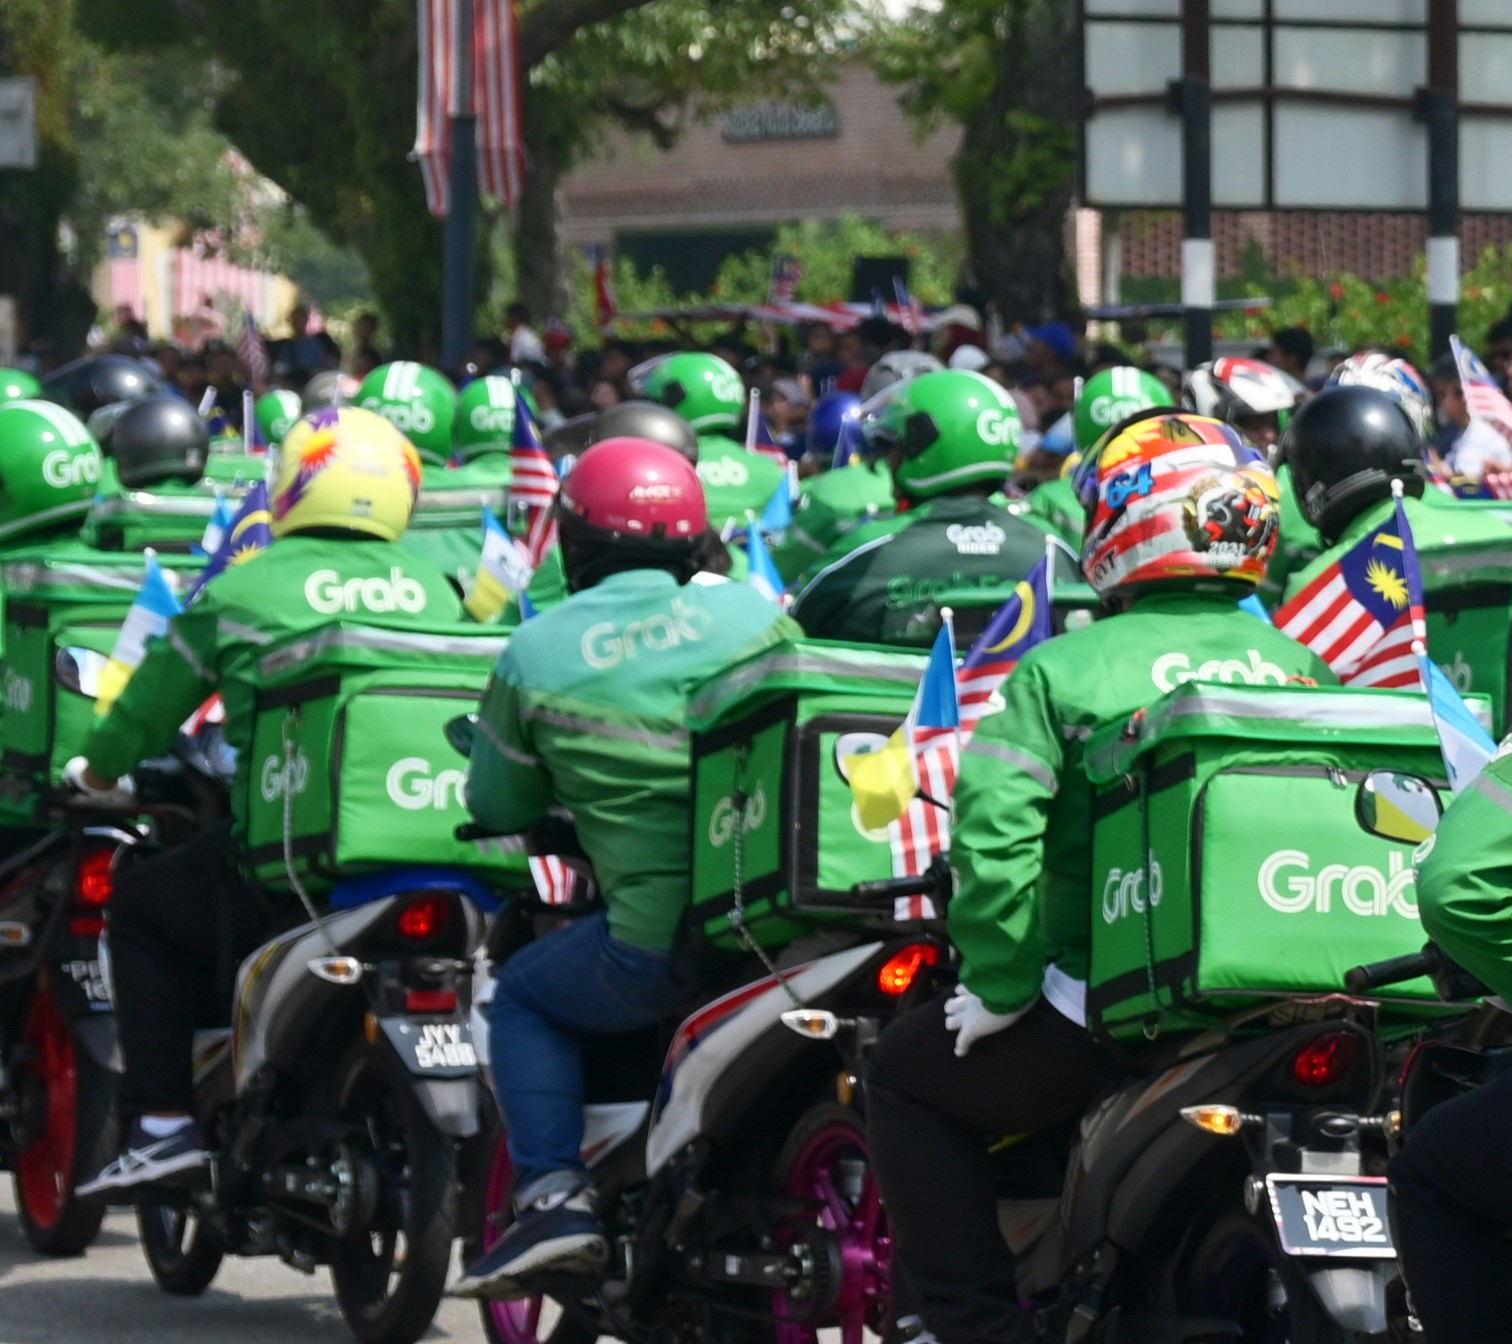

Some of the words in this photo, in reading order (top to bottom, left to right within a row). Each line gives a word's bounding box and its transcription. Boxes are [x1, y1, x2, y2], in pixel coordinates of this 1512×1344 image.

[470, 404, 515, 433] Gra
[976, 408, 1022, 447] Gr
[42, 450, 101, 489] Gra
[697, 455, 750, 487] rab
[946, 520, 1007, 546] Grab
[304, 567, 427, 615] Grab
[581, 597, 713, 670] Grab
[385, 756, 469, 810] Gr
[1101, 850, 1163, 925] Grab
[1257, 849, 1421, 919] Grab
[1301, 1189, 1376, 1218] NEH
[1303, 1215, 1388, 1244] 1492
